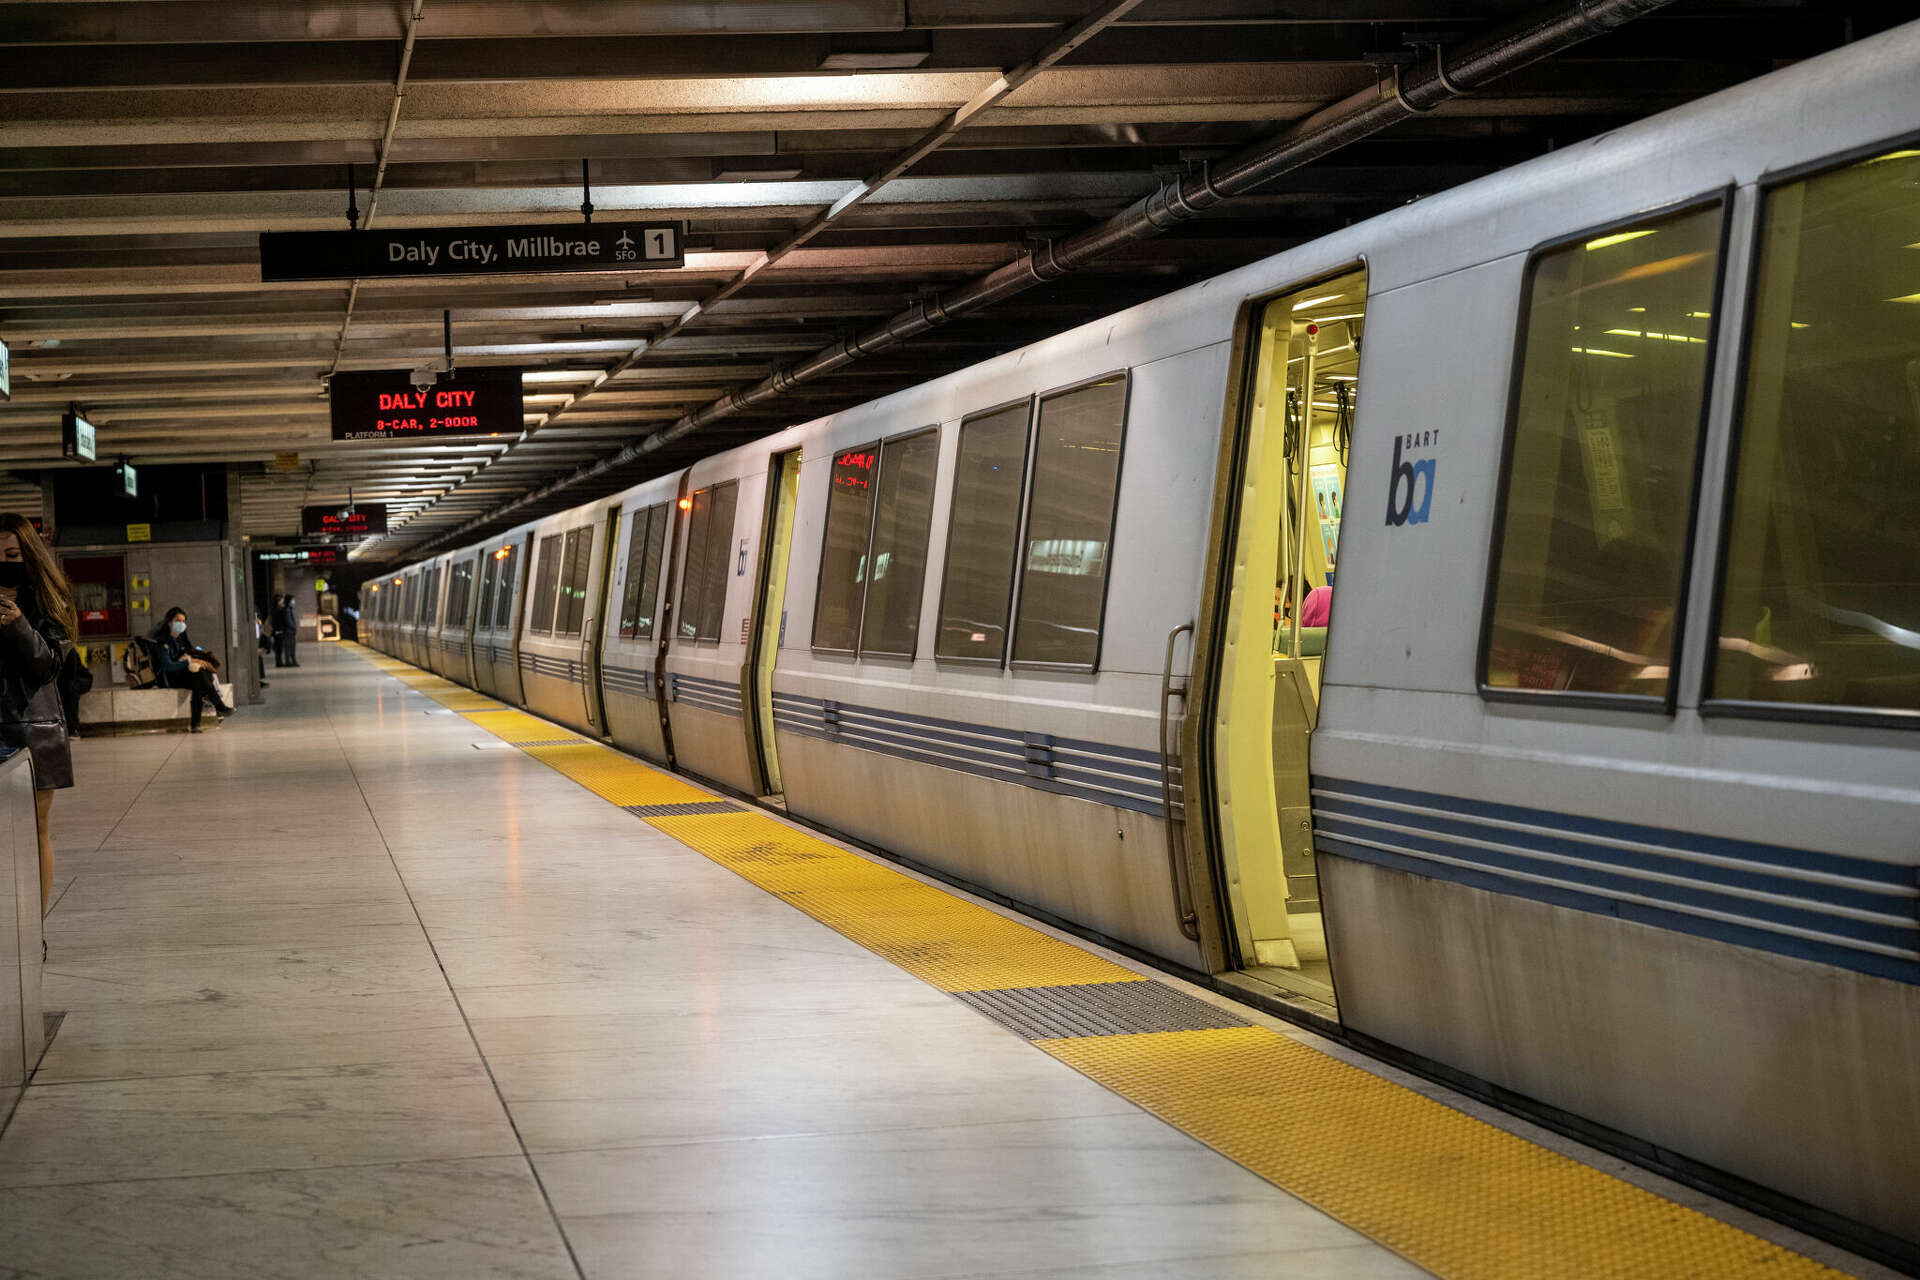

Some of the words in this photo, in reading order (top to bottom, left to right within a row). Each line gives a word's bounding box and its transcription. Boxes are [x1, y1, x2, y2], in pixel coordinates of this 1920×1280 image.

[388, 241, 440, 266] Daly
[447, 239, 499, 265] City,
[506, 236, 601, 258] Millbrae
[652, 232, 666, 255] 1
[615, 249, 637, 261] SFO
[378, 392, 428, 411] DALY
[435, 390, 476, 408] CITY
[376, 418, 424, 431] 8-CAR,
[429, 416, 479, 429] 2-DOOR
[344, 431, 387, 440] PLATFORM
[389, 431, 394, 439] 1
[1405, 428, 1440, 450] BART
